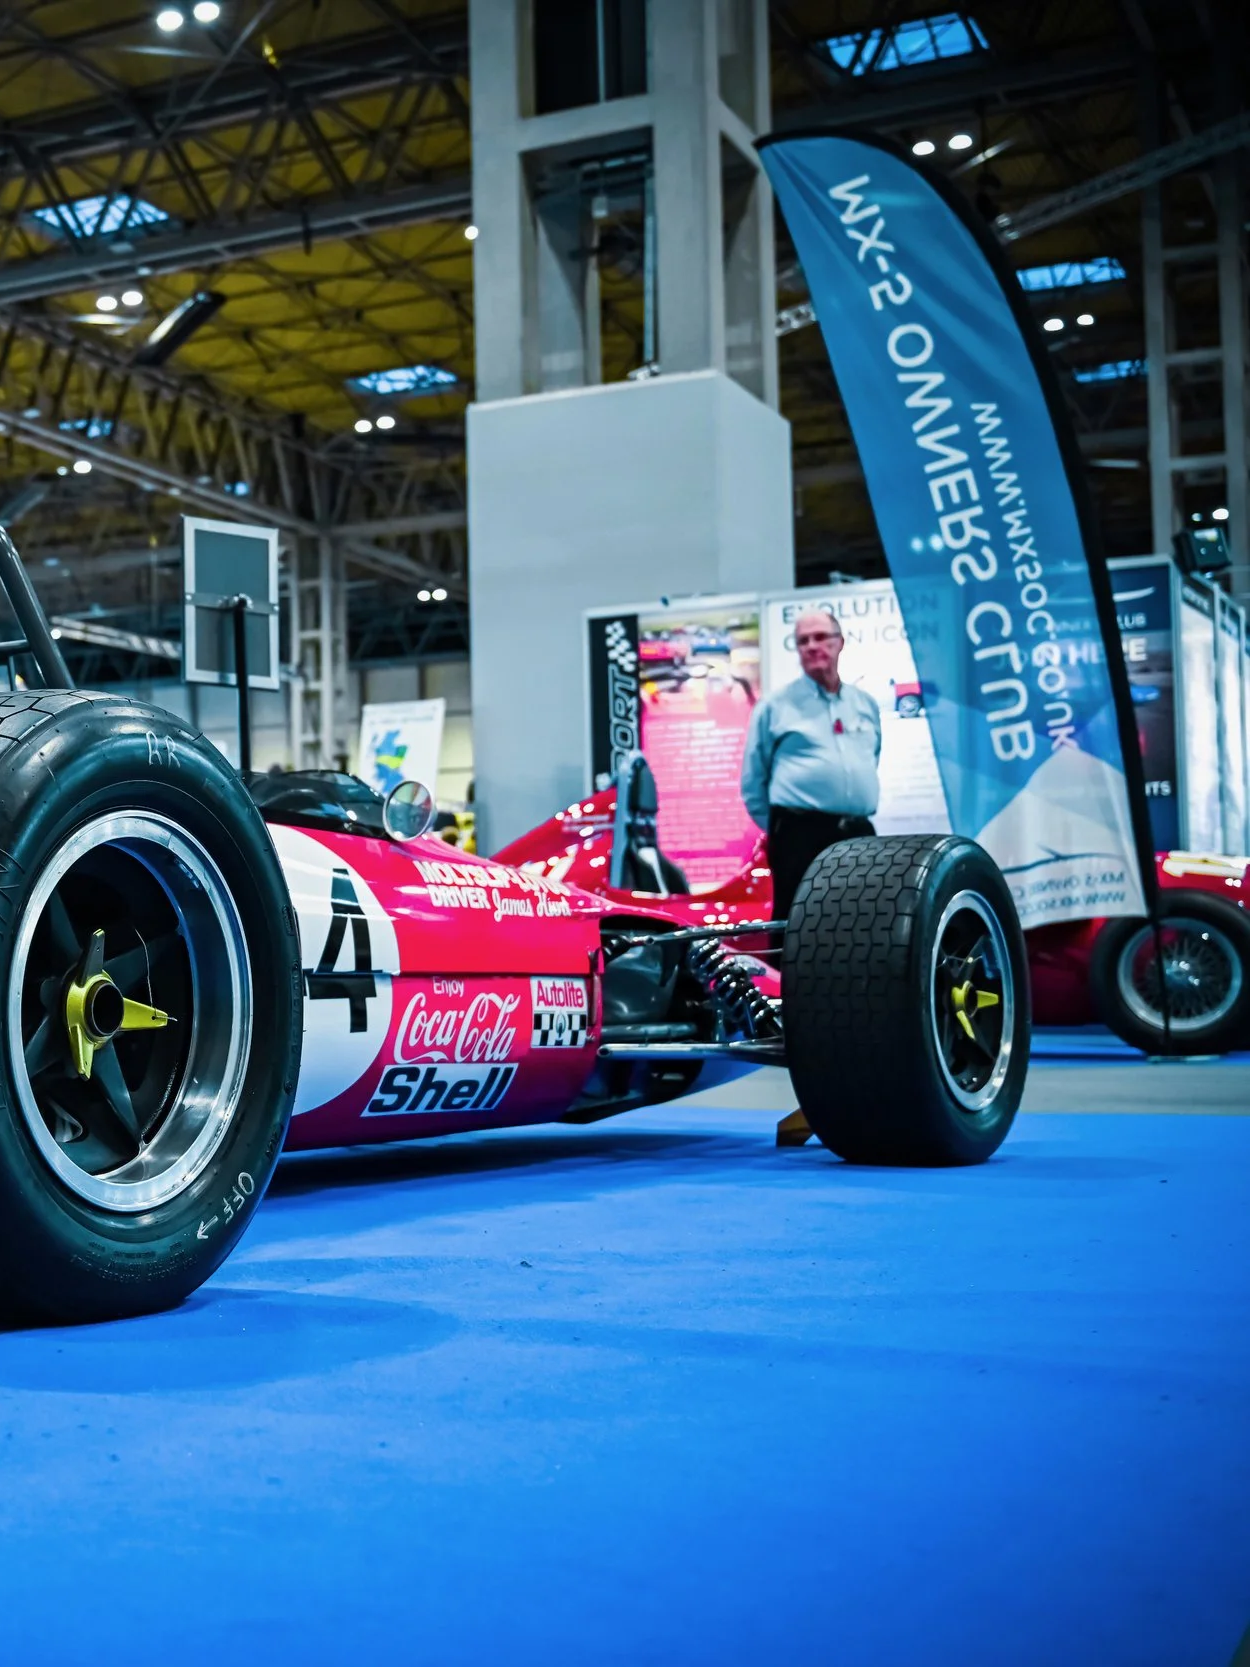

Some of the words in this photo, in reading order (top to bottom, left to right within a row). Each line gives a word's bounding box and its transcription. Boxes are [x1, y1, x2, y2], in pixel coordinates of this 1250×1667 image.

[427, 885, 491, 909] DRIVER
[492, 888, 535, 922] James
[303, 867, 377, 1033] 4
[433, 976, 465, 997] Enjoy
[536, 980, 584, 1008] Autolite
[393, 992, 521, 1063] Coca-Cola
[367, 1066, 515, 1113] Shell
